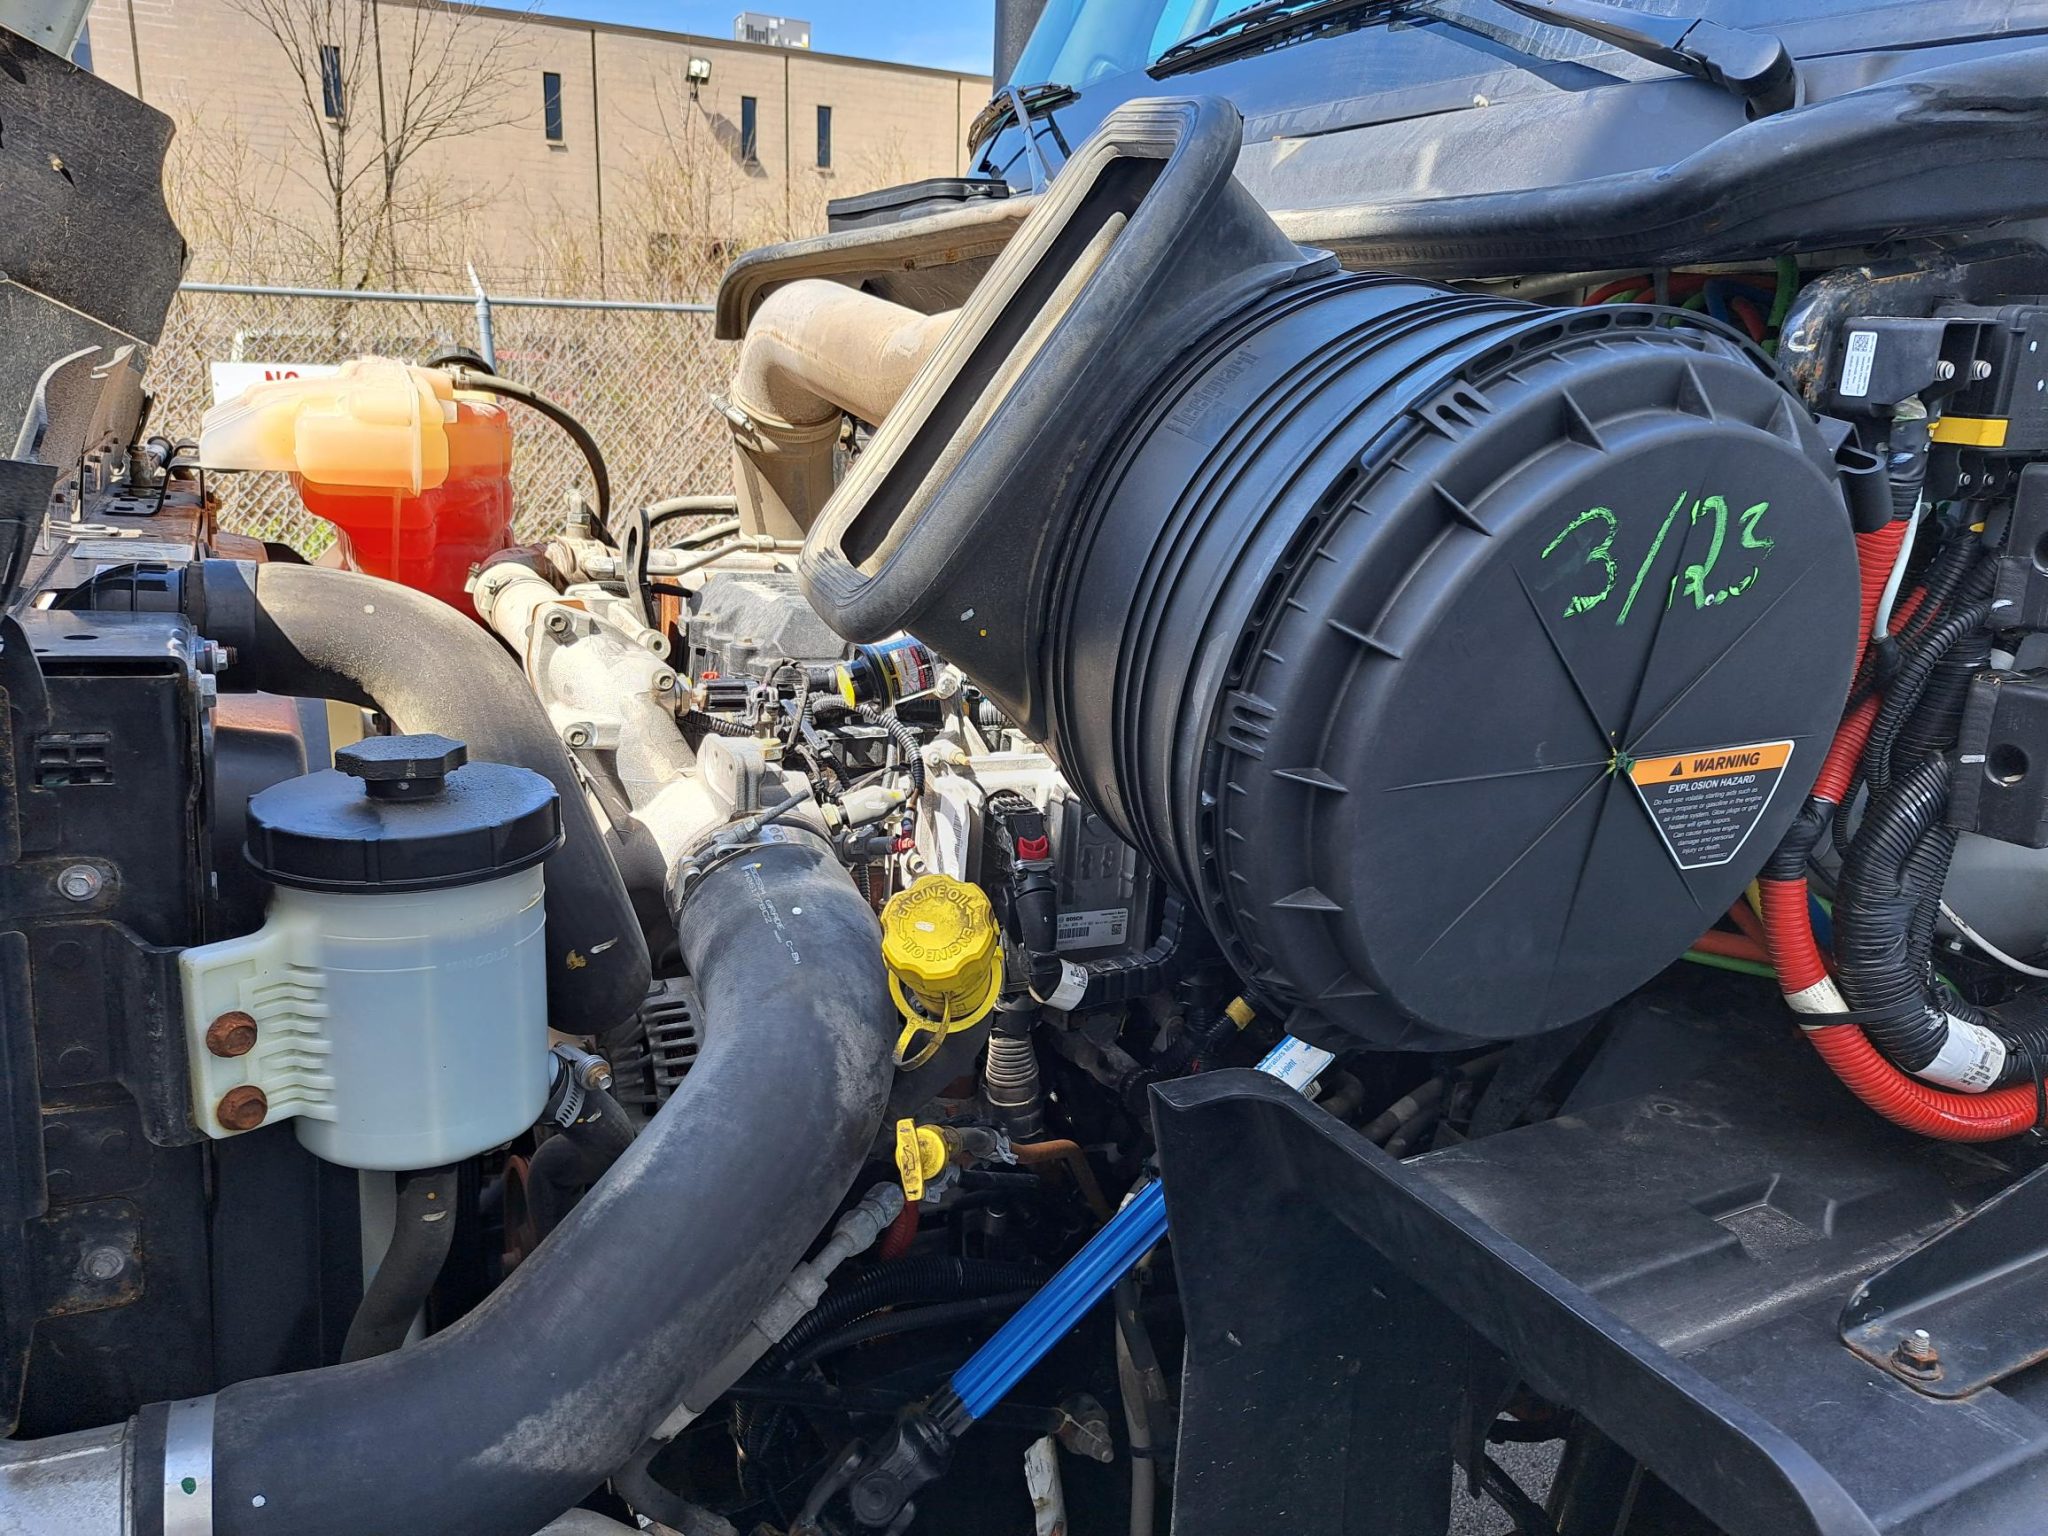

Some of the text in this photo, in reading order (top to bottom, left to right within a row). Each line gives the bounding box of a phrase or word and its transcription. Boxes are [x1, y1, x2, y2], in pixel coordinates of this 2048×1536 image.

[1693, 752, 1761, 773] WARNING
[1668, 774, 1756, 794] EXPLOSION HAZARD
[1674, 804, 1698, 813] propane
[1705, 799, 1729, 809] gasoline
[1744, 795, 1763, 804] engine
[1705, 791, 1725, 800] starting
[1711, 833, 1736, 842] personal
[1721, 824, 1740, 832] engine
[897, 885, 969, 919] ENGINE OIL
[902, 926, 976, 962] ENGINE OIL
[1275, 1058, 1297, 1079] U-joint
